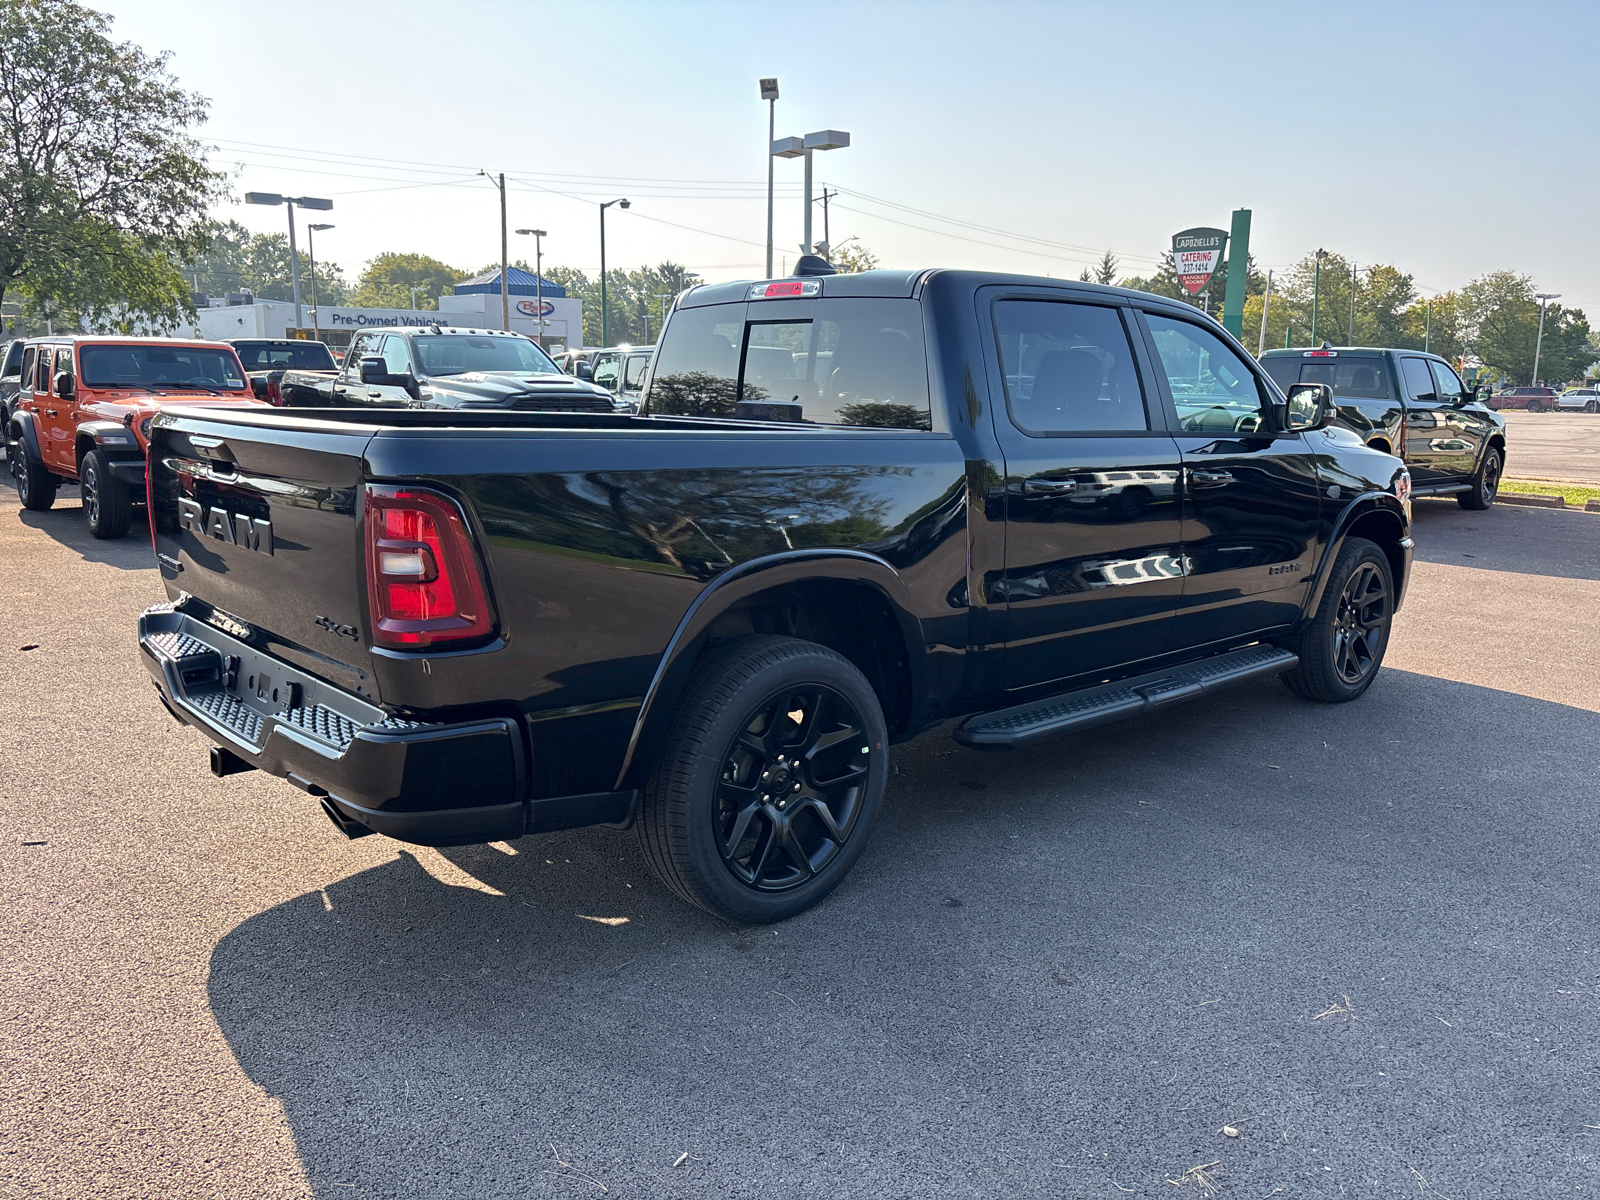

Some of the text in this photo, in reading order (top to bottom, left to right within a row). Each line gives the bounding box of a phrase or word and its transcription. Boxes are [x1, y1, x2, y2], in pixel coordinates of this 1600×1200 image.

[1176, 236, 1219, 248] CAPOZIELLO'S
[1181, 251, 1212, 263] CATERING
[1183, 262, 1208, 273] 237-1414
[332, 313, 449, 327] Pre-Owned Vehicles
[178, 497, 275, 556] RAM
[1268, 562, 1302, 576] RAM
